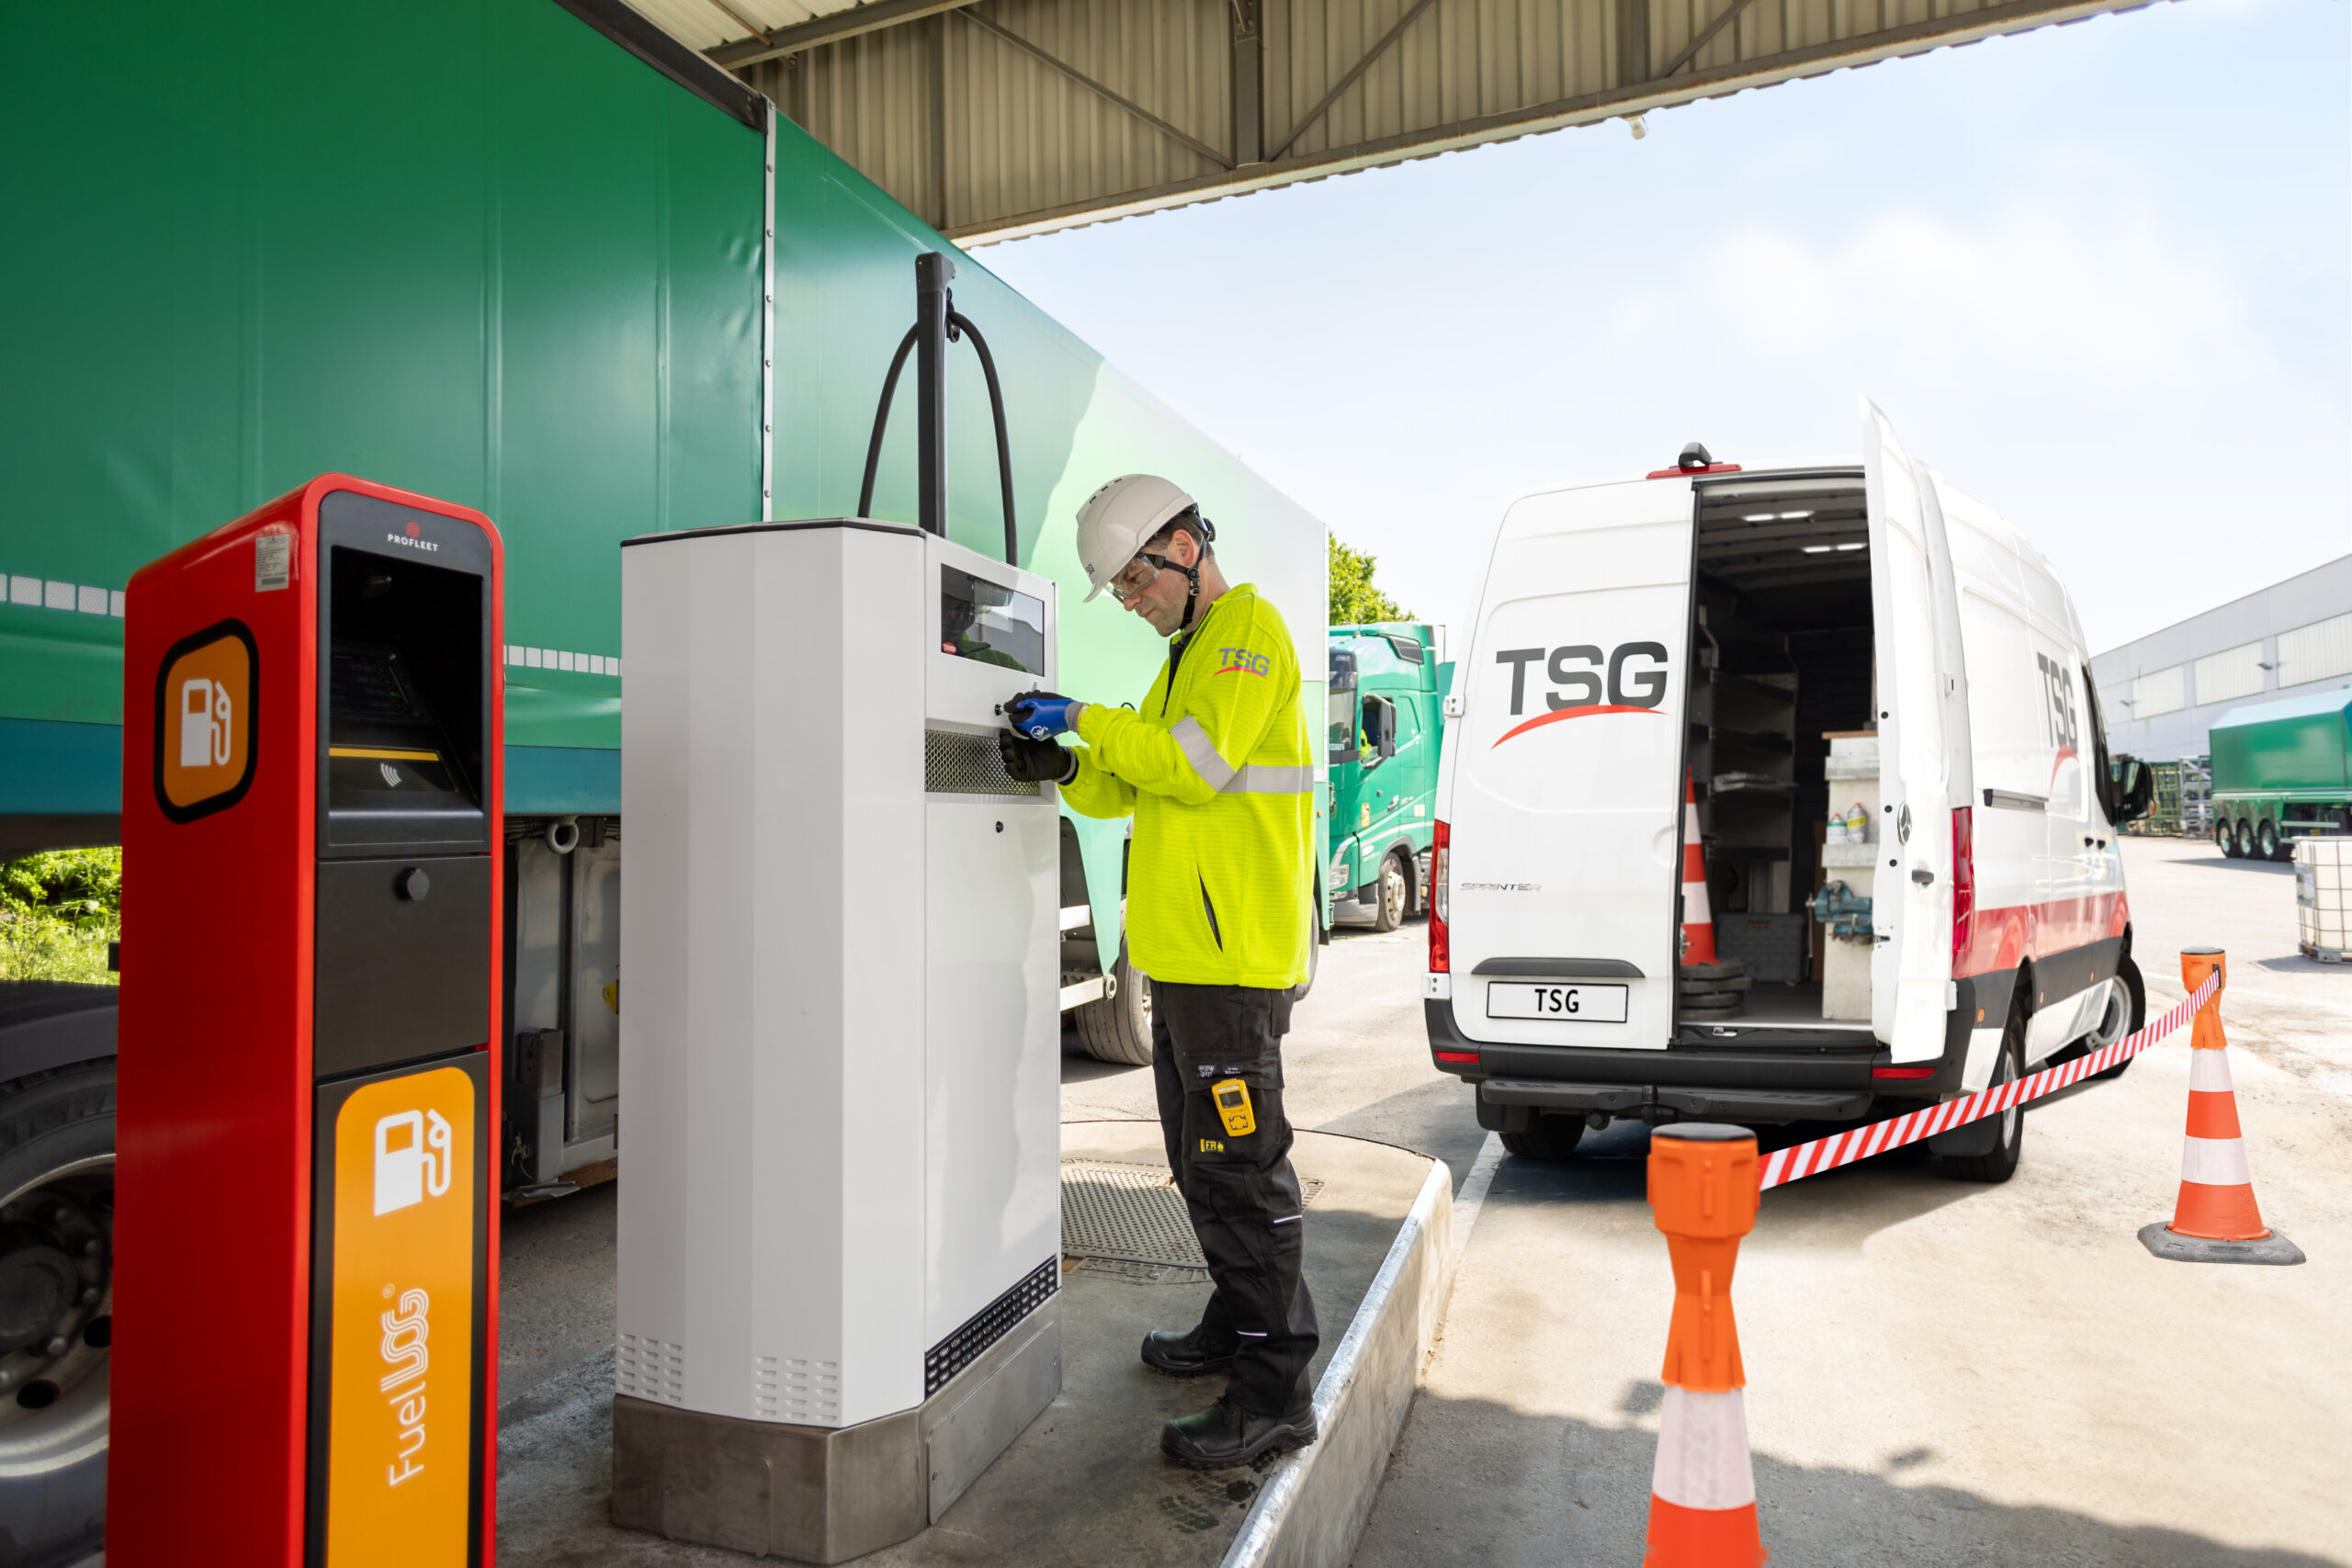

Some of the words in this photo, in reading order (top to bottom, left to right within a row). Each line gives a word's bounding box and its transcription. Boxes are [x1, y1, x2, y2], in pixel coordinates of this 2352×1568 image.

[387, 533, 439, 551] PROFLEET
[1218, 648, 1271, 677] TSG
[1496, 640, 1668, 716] TSG
[2037, 650, 2078, 755] TSG
[1459, 882, 1544, 892] SPRINTER
[1534, 987, 1579, 1014] TSG
